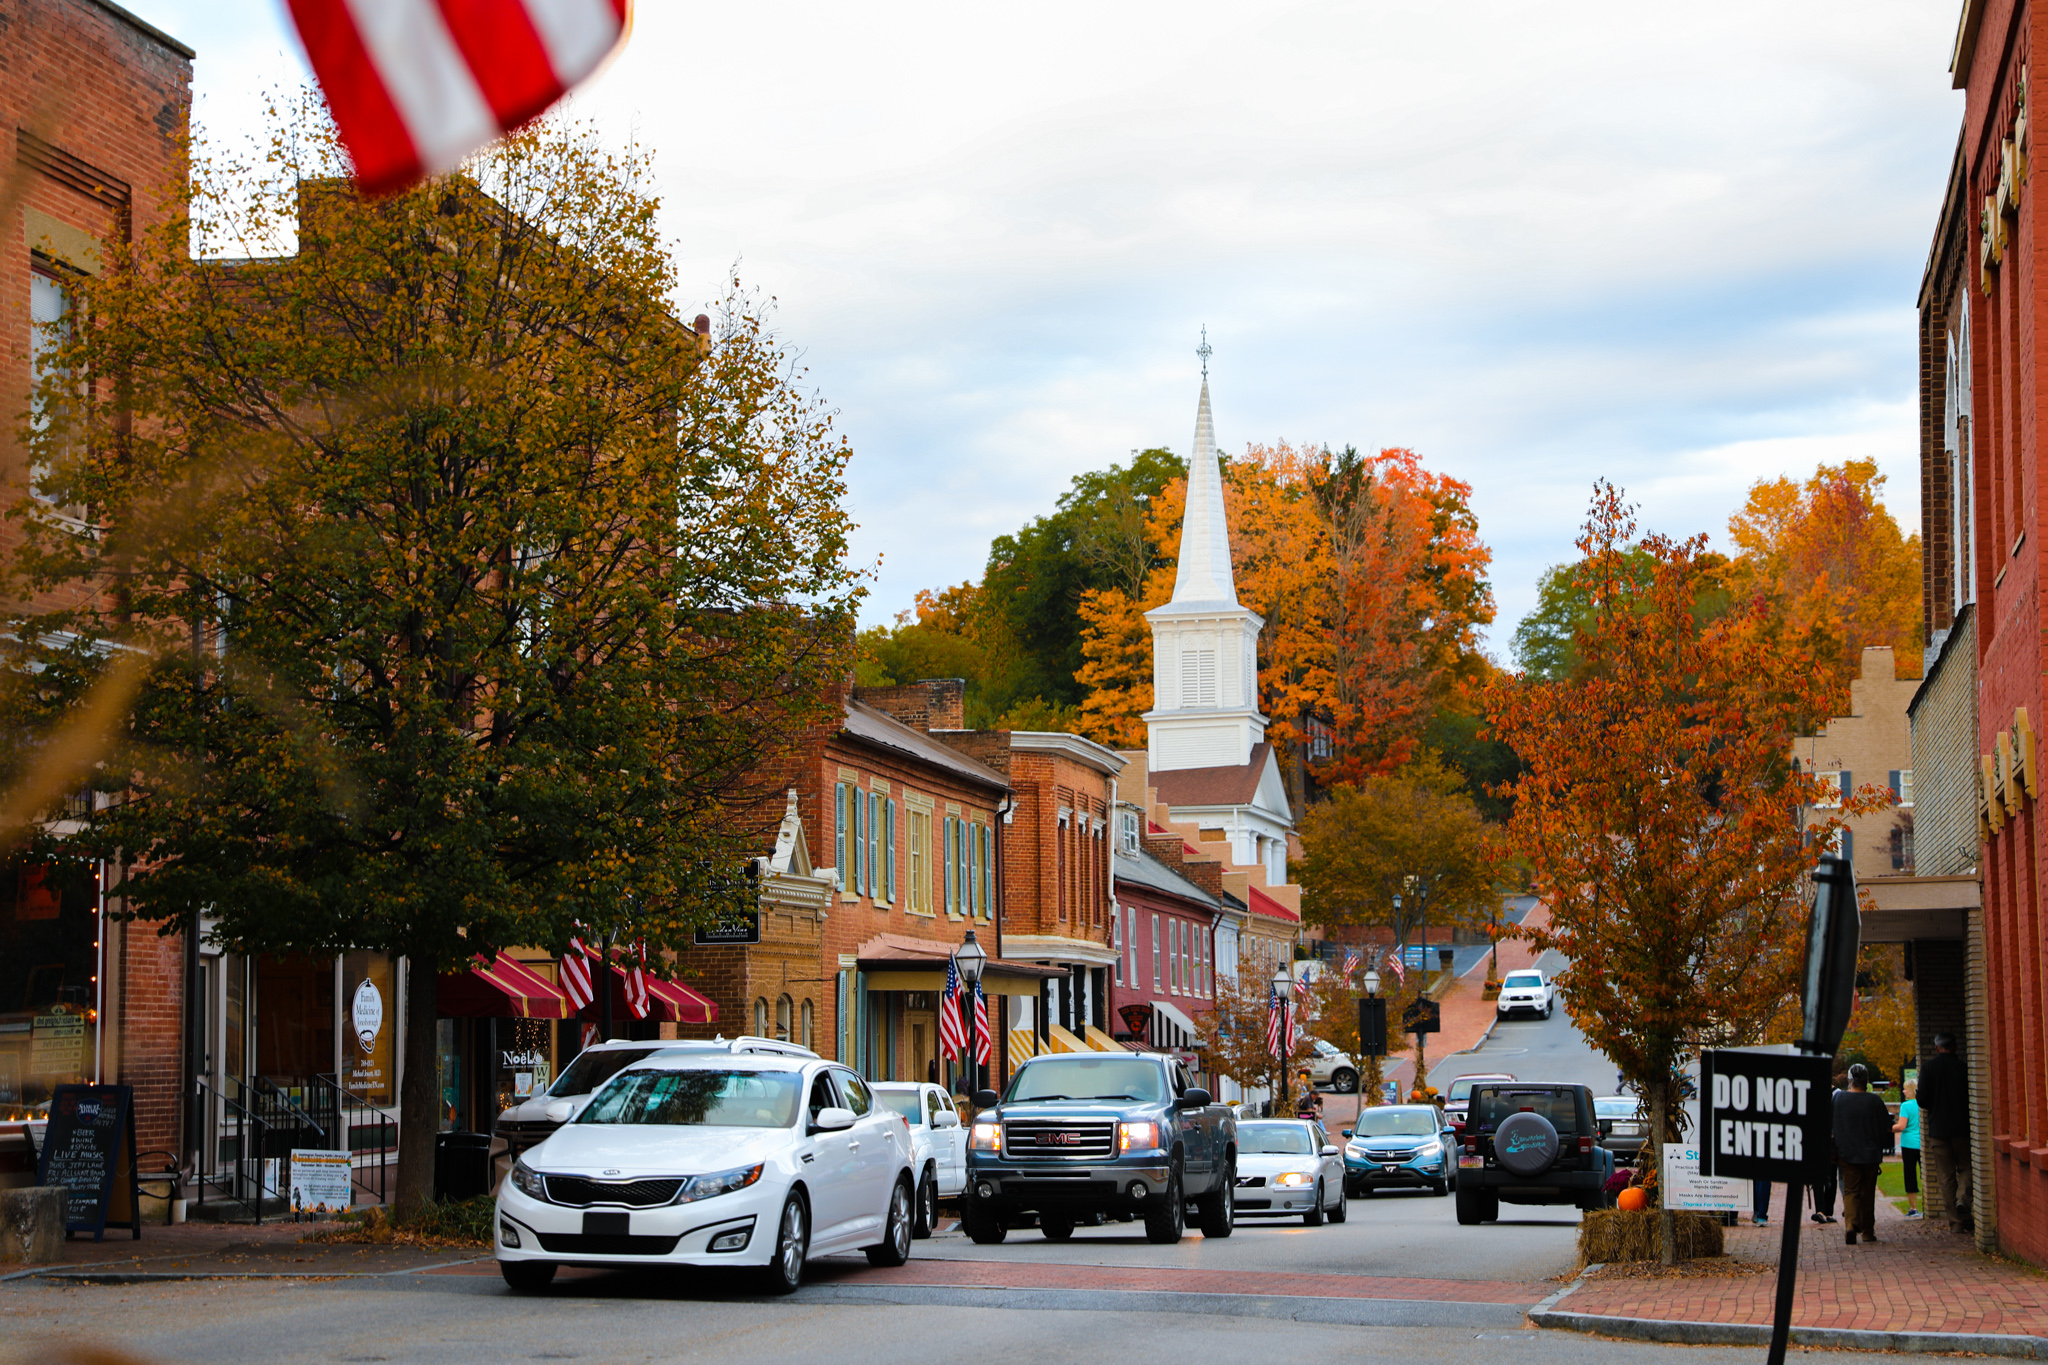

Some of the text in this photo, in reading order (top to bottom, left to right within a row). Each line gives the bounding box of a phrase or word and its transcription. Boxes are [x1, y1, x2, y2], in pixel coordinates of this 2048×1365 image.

[360, 991, 375, 1004] Family
[356, 1004, 375, 1016] Medicine
[1713, 1073, 1811, 1115] DO NOT
[1035, 1133, 1081, 1144] GMC
[1720, 1119, 1803, 1161] ENTER
[53, 1149, 104, 1160] LIVE MUSIC
[1685, 1149, 1700, 1160] St
[1384, 1165, 1397, 1173] VT
